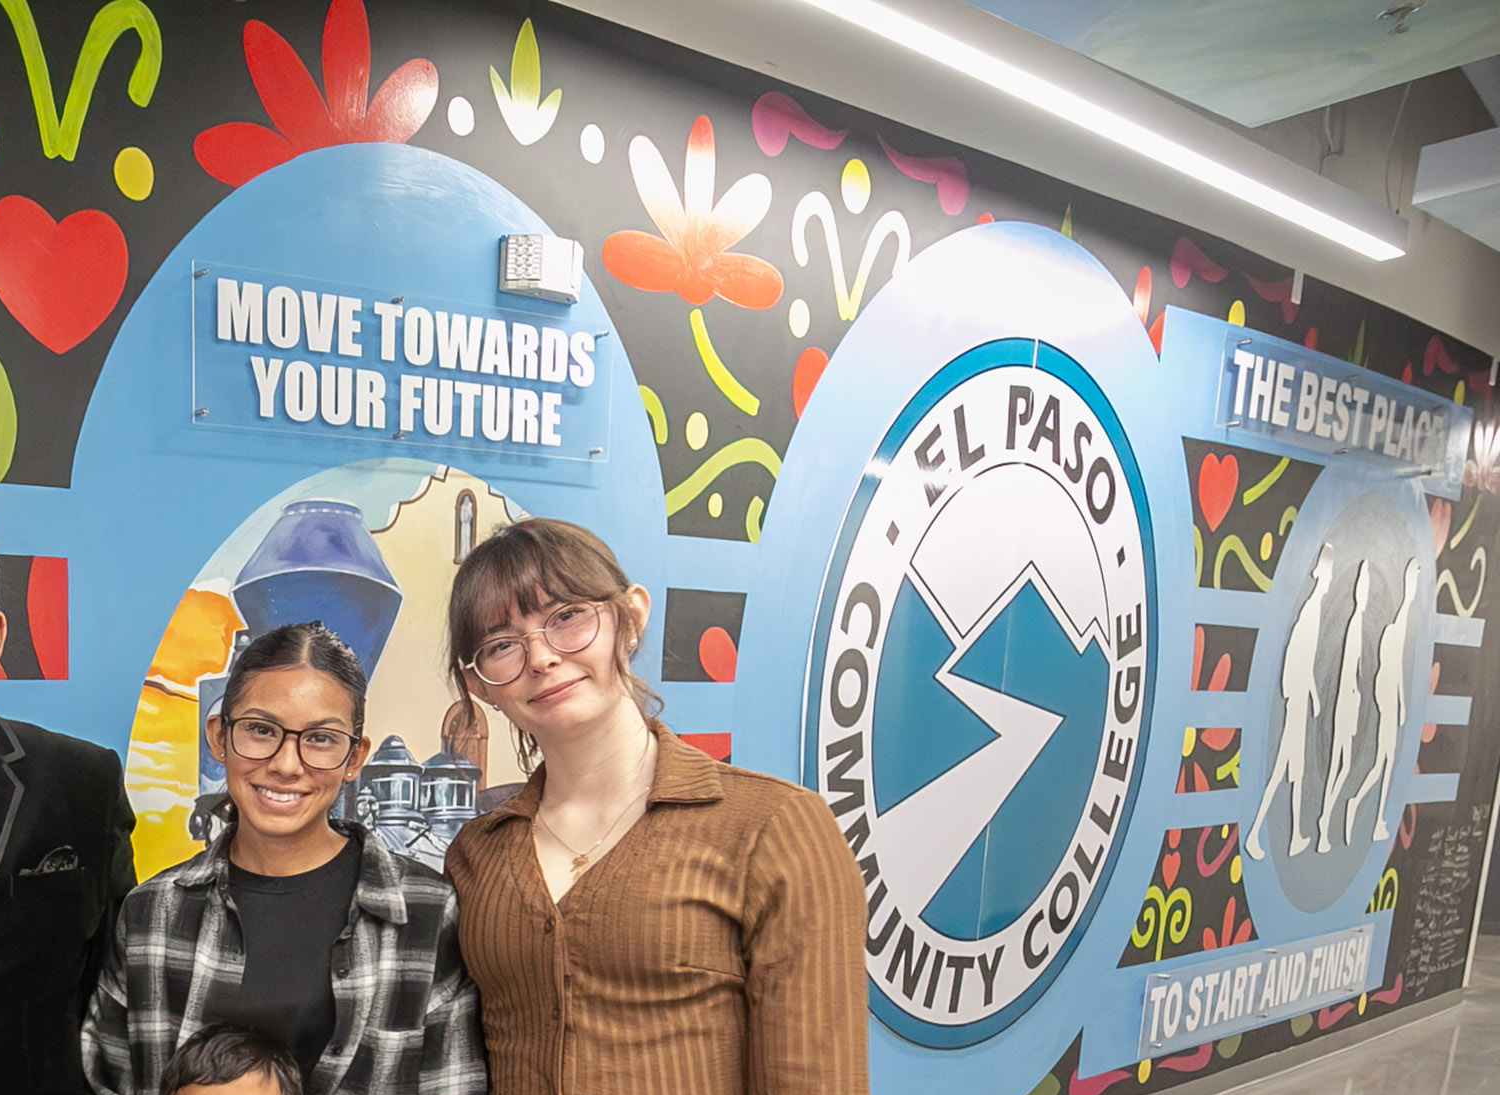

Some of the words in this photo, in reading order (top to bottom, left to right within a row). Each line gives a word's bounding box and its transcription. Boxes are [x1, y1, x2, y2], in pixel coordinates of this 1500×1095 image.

[216, 278, 363, 357] MOVE
[374, 301, 596, 388] TOWARDS
[250, 356, 387, 430] YOUR
[399, 374, 562, 447] FUTURE
[1233, 349, 1296, 427] THE
[1296, 370, 1370, 446] BEST
[913, 404, 987, 509] EL
[1005, 385, 1117, 525] PASO
[1022, 602, 1143, 970] COLLEGE
[1150, 981, 1183, 1043] TO
[1185, 962, 1263, 1033] START
[1259, 952, 1308, 1013] AND
[1306, 935, 1371, 998] FINISH
